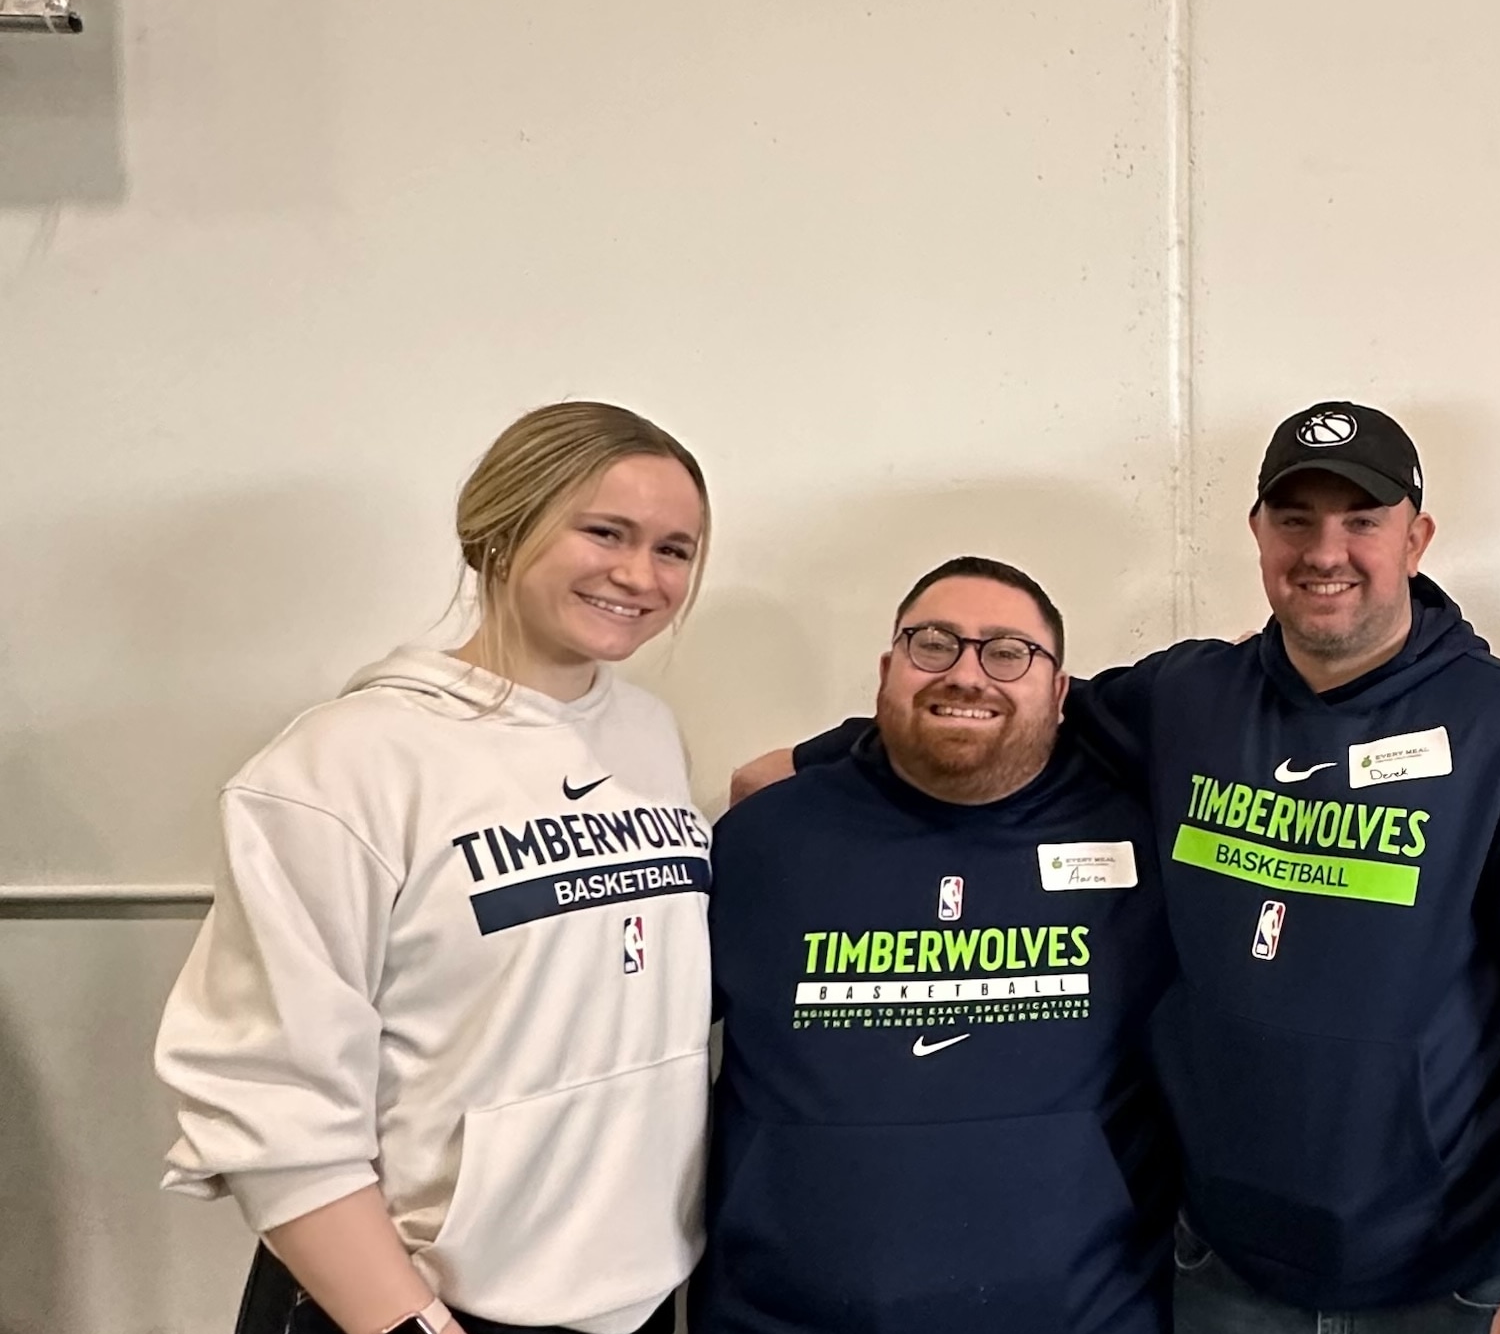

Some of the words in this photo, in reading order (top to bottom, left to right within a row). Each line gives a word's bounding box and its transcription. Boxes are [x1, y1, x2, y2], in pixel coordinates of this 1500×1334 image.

[1375, 750, 1404, 760] EVERY
[1187, 773, 1431, 858] TIMBERWOLVES
[452, 806, 710, 883] TIMBERWOLVES
[1068, 866, 1107, 885] Aaron
[1215, 843, 1349, 888] BASKETBALL
[553, 863, 693, 906] BASKETBALL
[803, 925, 1091, 975] TIMBERWOLVES
[818, 978, 1067, 1001] BASKETBALL
[792, 1019, 812, 1030] OF
[823, 1019, 852, 1029] THE
[862, 1016, 956, 1027] MINNESOTA
[967, 1008, 1090, 1025] TIMBERWOLVES
[793, 1008, 872, 1020] ENGINEERED
[878, 1007, 894, 1018] TO
[900, 1007, 923, 1017] THE
[928, 1005, 969, 1016] EXACT
[975, 998, 1090, 1014] SPECIFICATIONS
